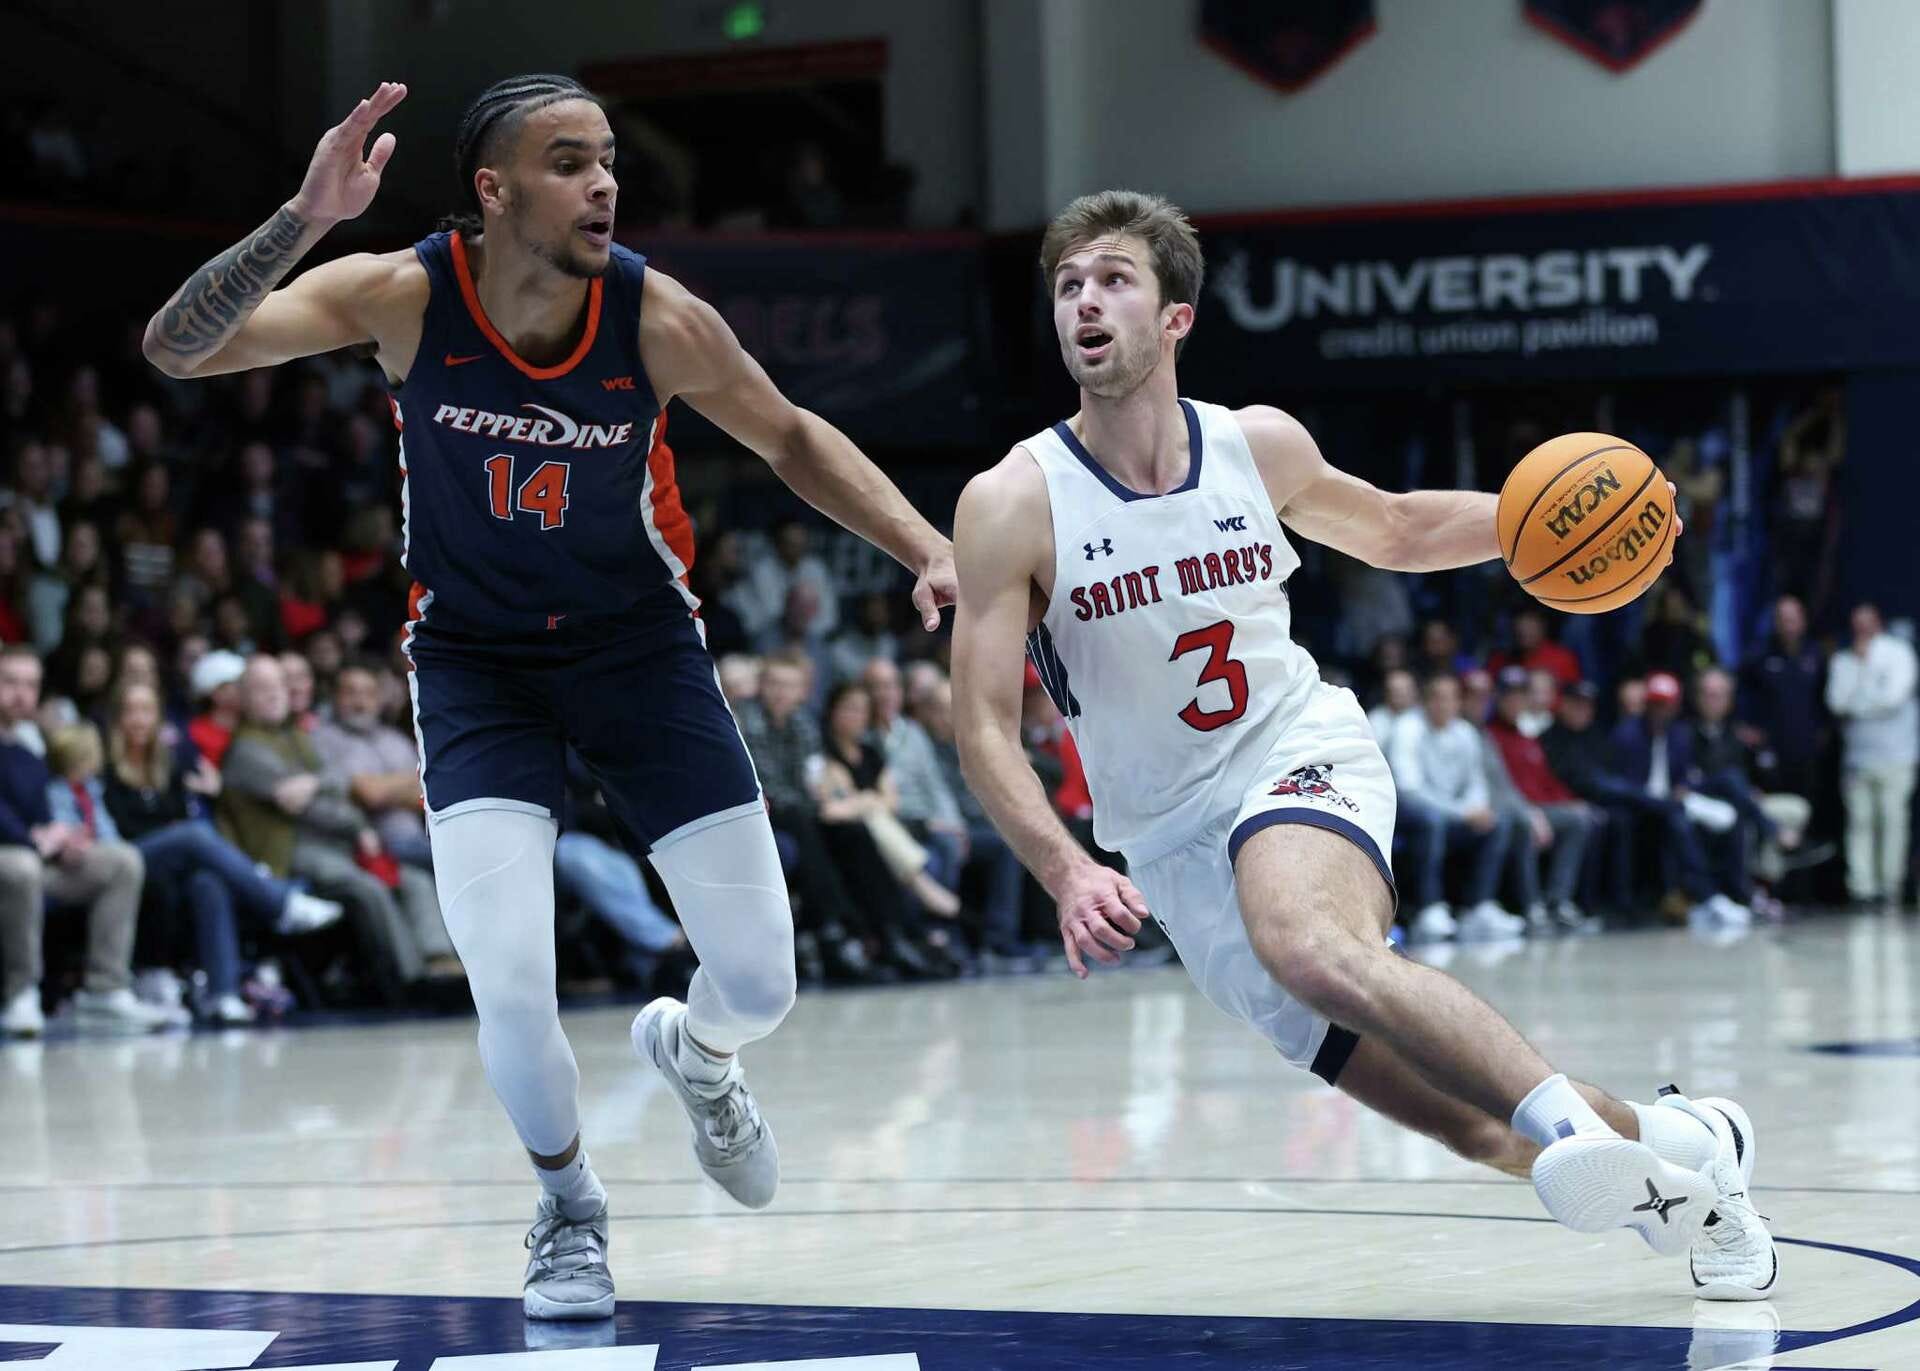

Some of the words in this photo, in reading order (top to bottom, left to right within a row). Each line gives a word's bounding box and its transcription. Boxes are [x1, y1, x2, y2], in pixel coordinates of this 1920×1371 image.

[1224, 243, 1710, 332] UNIVERSITY
[1319, 321, 1414, 359] credit
[1419, 320, 1519, 354] union
[1521, 308, 1658, 359] pavilion
[601, 376, 635, 391] WCC
[433, 403, 634, 449] PEPPERDINE
[484, 453, 571, 531] 14
[1213, 516, 1248, 533] WCC
[1546, 467, 1622, 540] NCAA
[1565, 500, 1666, 585] Wilson
[1070, 565, 1163, 622] SAINT
[1174, 542, 1273, 596] MARY'S
[1168, 619, 1249, 732] 3
